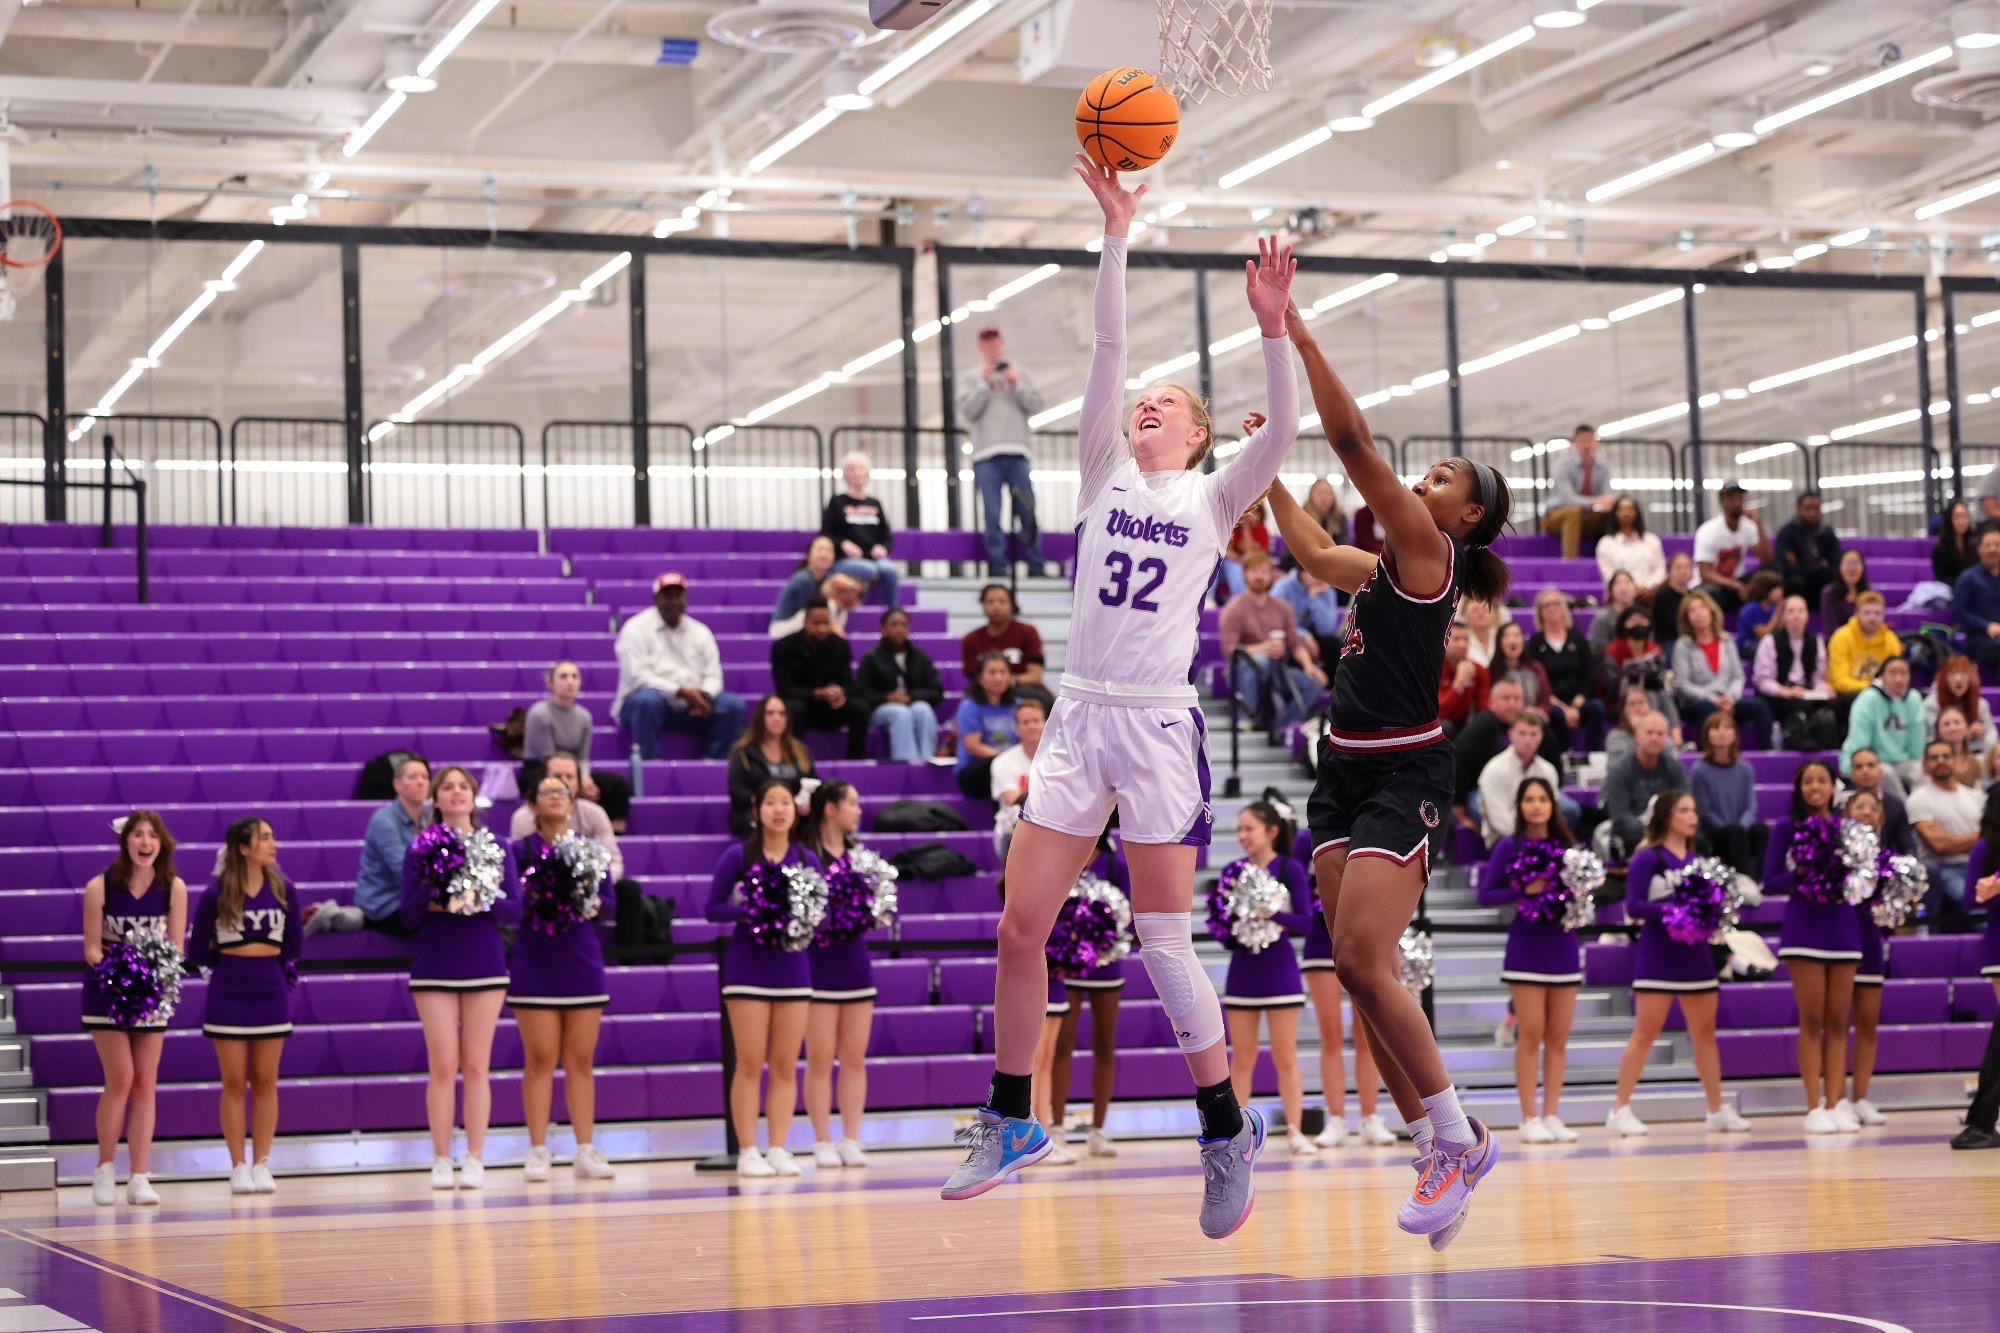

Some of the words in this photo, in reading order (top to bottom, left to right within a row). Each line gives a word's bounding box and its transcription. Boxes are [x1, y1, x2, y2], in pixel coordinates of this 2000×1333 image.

[1106, 507, 1192, 548] Violets
[1098, 549, 1167, 613] 32
[106, 915, 167, 935] NYU
[226, 908, 282, 932] YU
